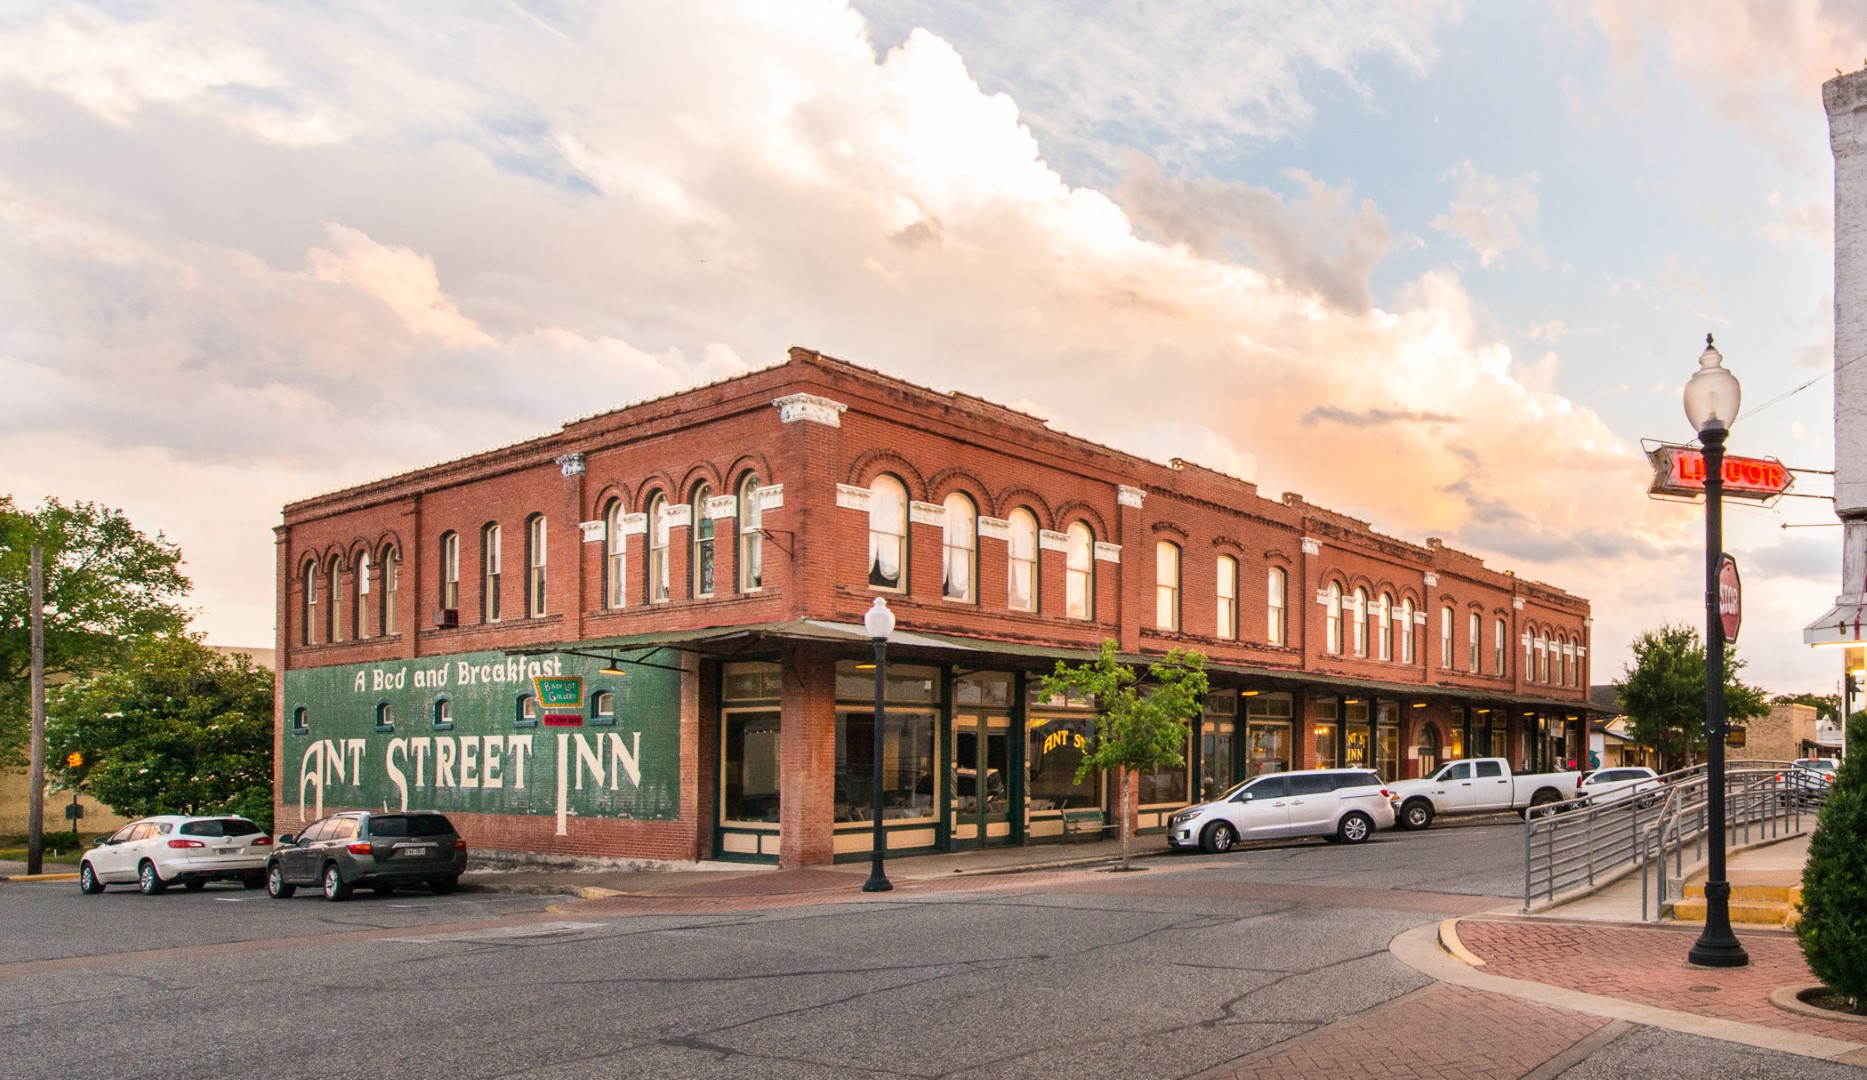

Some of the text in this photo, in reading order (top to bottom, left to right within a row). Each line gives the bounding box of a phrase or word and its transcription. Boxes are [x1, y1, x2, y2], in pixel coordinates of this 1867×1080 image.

[1679, 457, 1782, 487] LIUOR
[1720, 583, 1737, 615] STOP
[355, 656, 562, 692] A Bed and Breakfast
[1043, 730, 1069, 755] ANT
[1347, 748, 1363, 761] INN
[300, 732, 641, 836] ANT STREET INN
